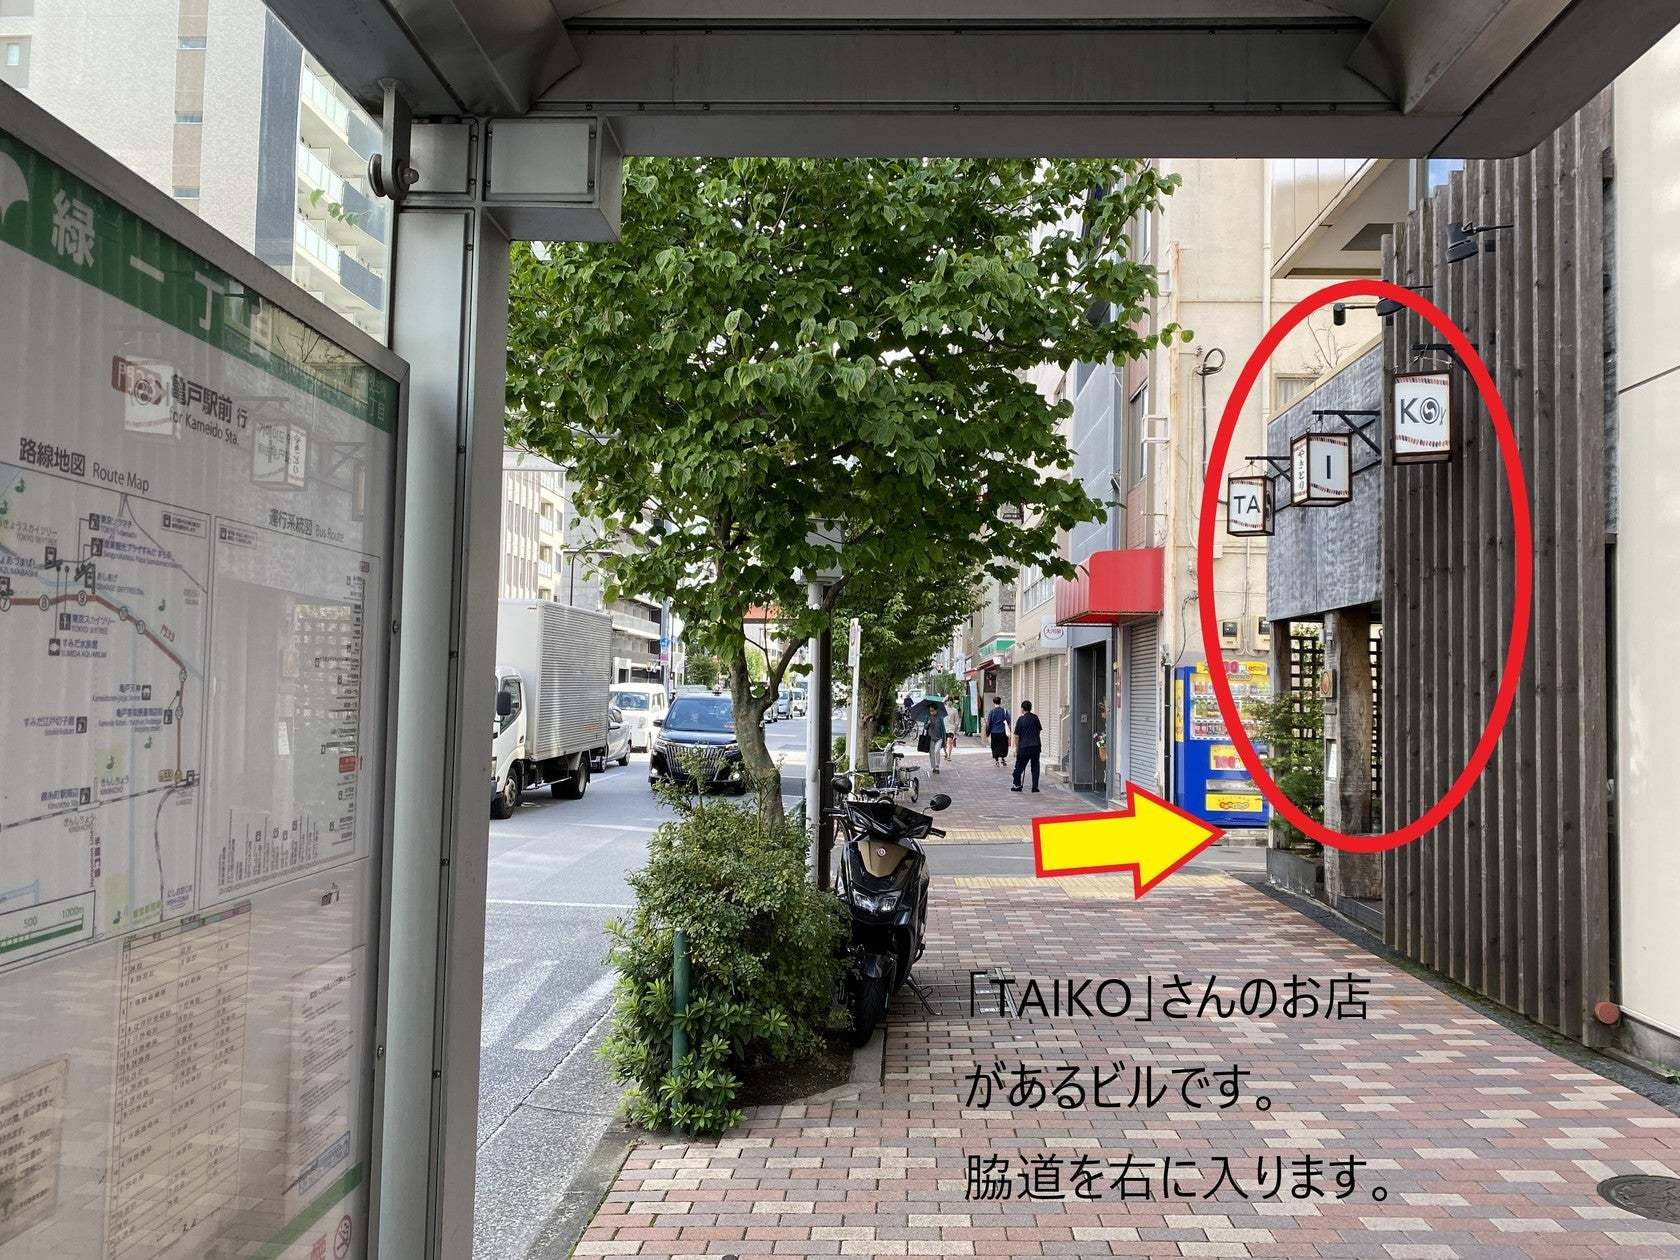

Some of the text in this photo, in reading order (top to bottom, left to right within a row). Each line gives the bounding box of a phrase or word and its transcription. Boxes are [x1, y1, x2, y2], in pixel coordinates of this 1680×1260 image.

[186, 413, 223, 440] Kameido
[225, 428, 239, 447] Sta.
[237, 407, 248, 429] 行
[19, 436, 86, 477] 路線地図
[92, 461, 150, 494] Route Map
[1233, 495, 1261, 514] TA
[23, 915, 38, 929] 500
